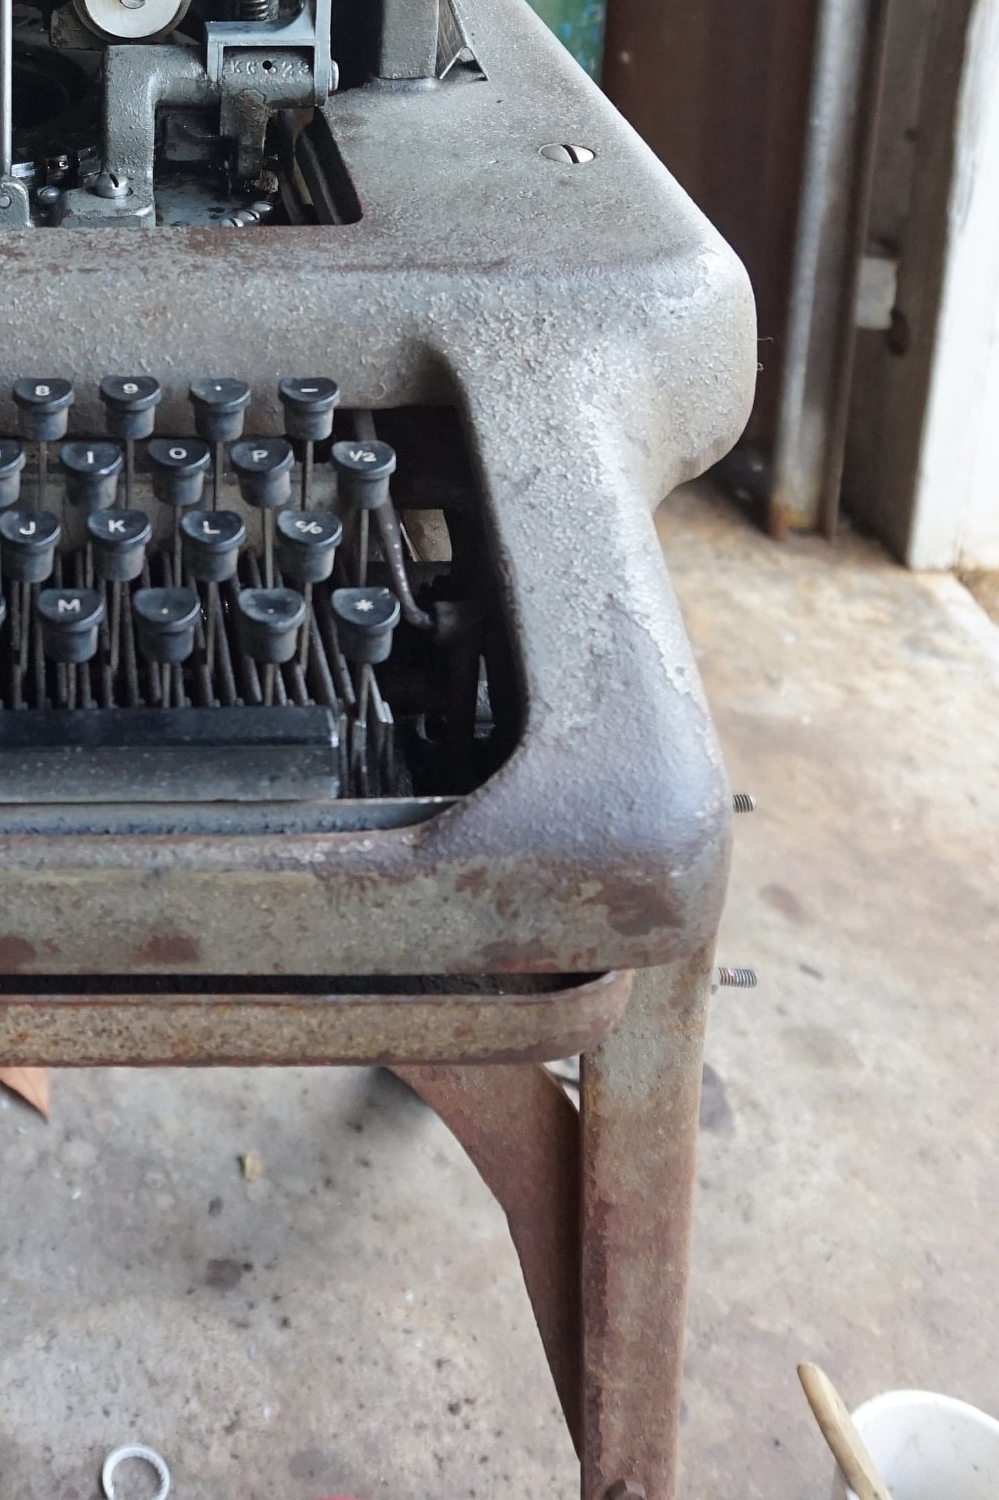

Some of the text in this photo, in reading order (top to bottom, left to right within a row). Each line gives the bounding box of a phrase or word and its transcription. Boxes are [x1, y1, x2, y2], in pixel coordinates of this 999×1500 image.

[35, 385, 51, 396] 8
[122, 383, 139, 394] 9
[251, 449, 268, 463] P
[19, 521, 36, 535] J
[108, 519, 126, 533] K
[202, 520, 221, 535] L
[57, 598, 81, 613] M
